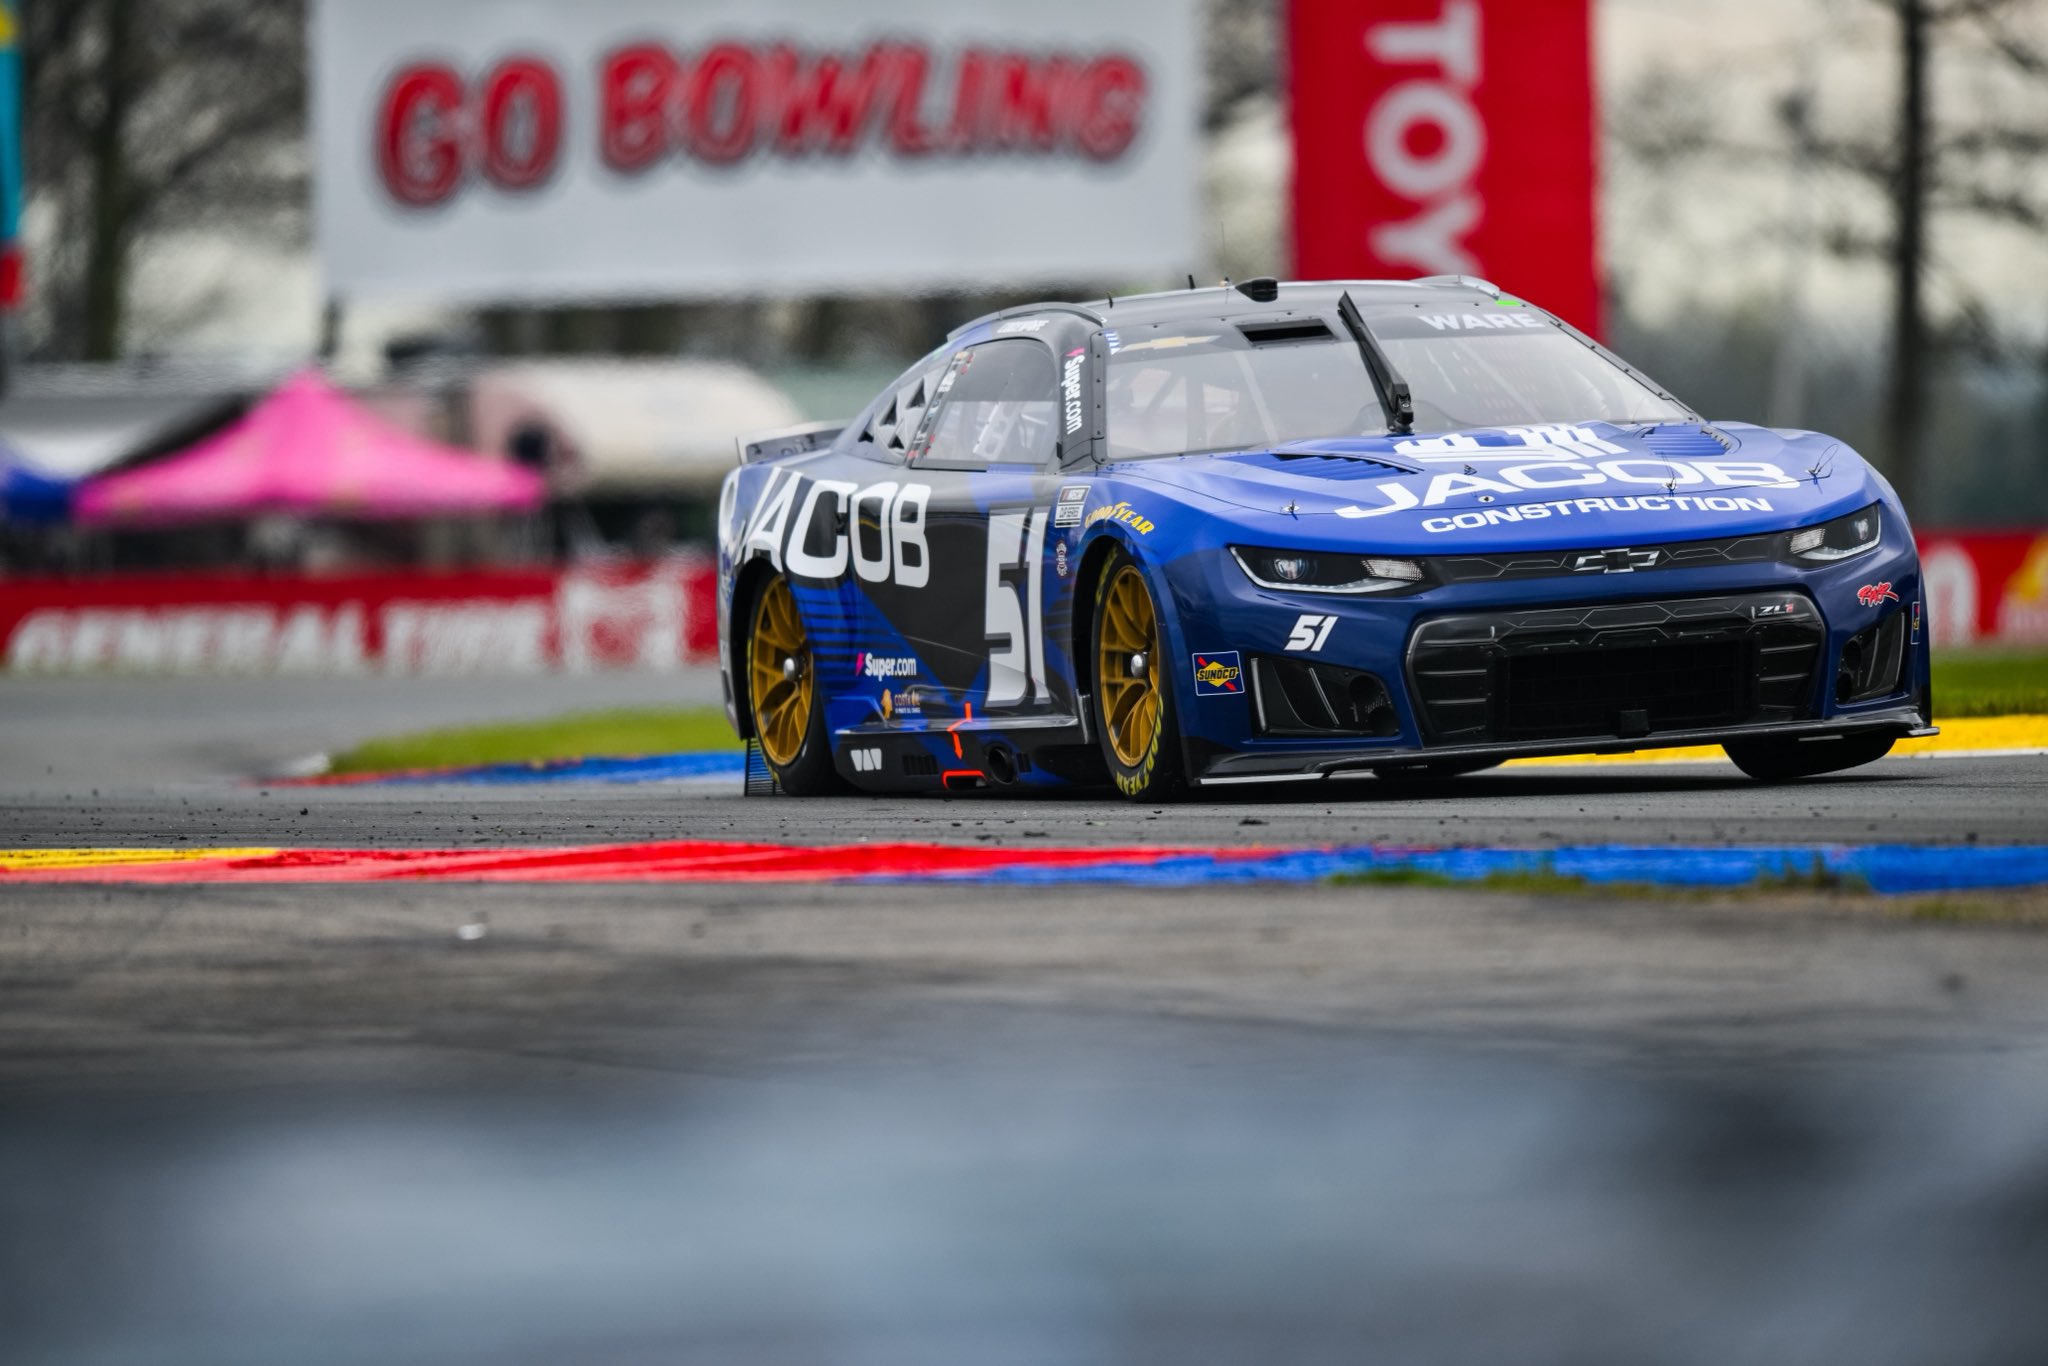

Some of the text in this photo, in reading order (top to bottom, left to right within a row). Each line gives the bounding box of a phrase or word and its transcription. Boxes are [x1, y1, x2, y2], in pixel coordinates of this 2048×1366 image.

[377, 40, 1146, 208] GO BOWLING
[1418, 312, 1545, 331] WARE
[1334, 459, 1799, 518] JACOB
[734, 467, 931, 588] JACOB
[1084, 501, 1155, 535] GOODYEAR
[1421, 497, 1773, 533] CONSTRUCTION
[984, 505, 1052, 707] 51
[1758, 603, 1794, 616] ZL1
[1284, 614, 1339, 651] 51
[865, 652, 916, 681] Super.com
[1198, 668, 1237, 680] SUNOCO
